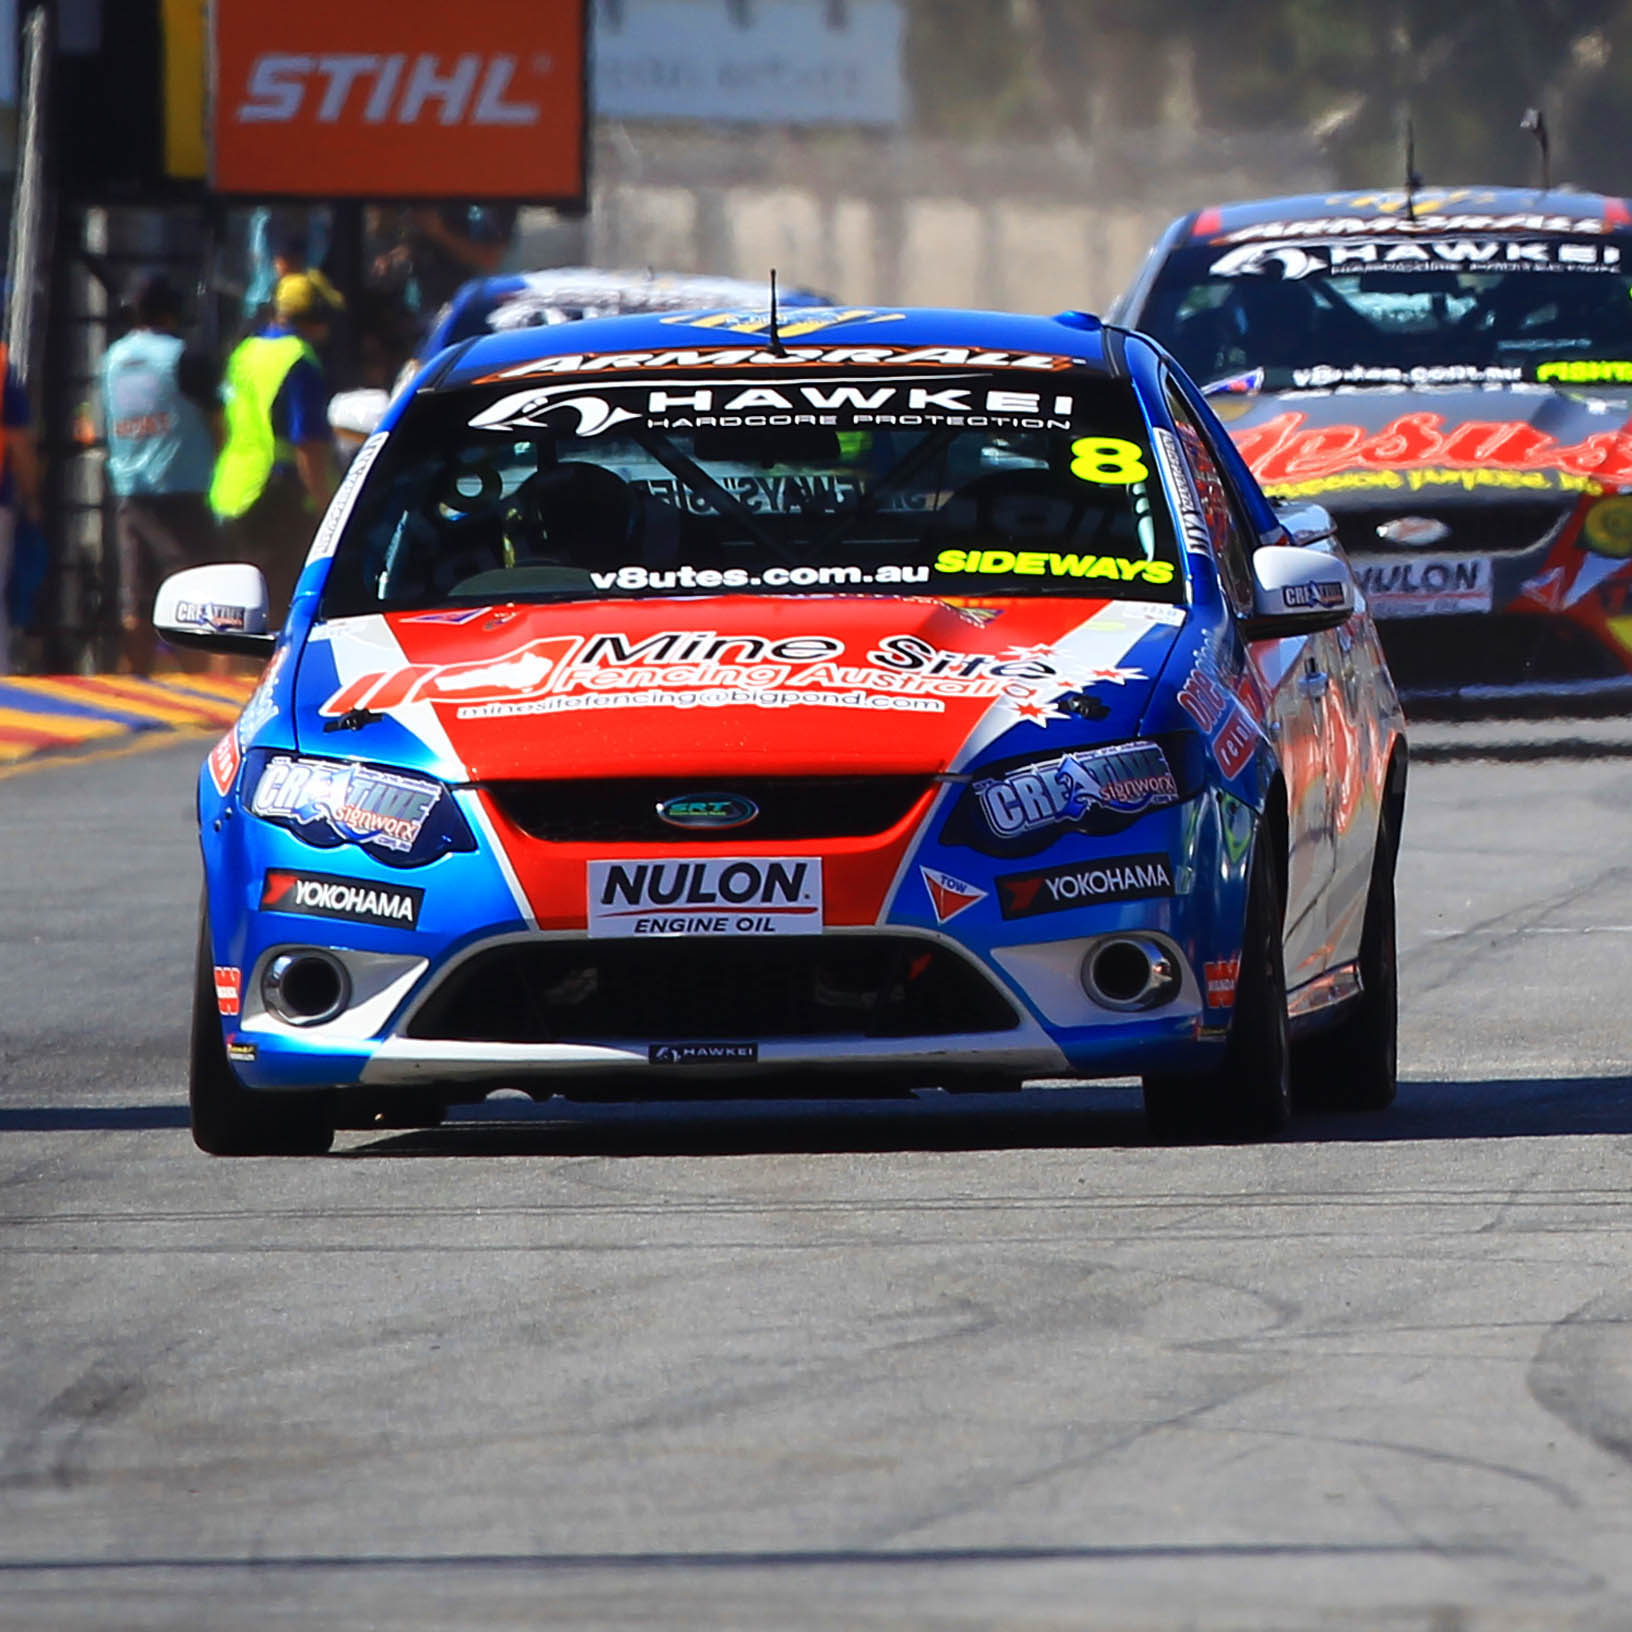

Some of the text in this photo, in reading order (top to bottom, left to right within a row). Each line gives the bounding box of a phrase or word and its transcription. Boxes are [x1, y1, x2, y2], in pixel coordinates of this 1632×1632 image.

[236, 52, 540, 126] STIHL
[1330, 243, 1620, 264] HAWKEI
[649, 387, 1073, 416] HAWKEI
[648, 415, 1071, 430] HARDCORE PROTECTION
[1071, 437, 1149, 485] 8
[590, 565, 929, 591] v8utes.com.au
[934, 550, 1175, 584] SIDEWAYS
[580, 631, 1057, 680] Mine Site
[556, 663, 1042, 699] Fencing Australia
[458, 688, 945, 719] minesitefencing@bigpond.com
[255, 762, 433, 820] CREATIVE
[987, 749, 1169, 831] CREATIVE
[1102, 775, 1174, 801] signworx
[335, 804, 421, 841] signworx
[599, 862, 808, 905] NULON
[939, 874, 968, 895] TOW
[1045, 864, 1170, 900] YOKOHAMA
[296, 880, 413, 921] YOKOHAMA
[634, 917, 776, 934] ENGINE OIL
[683, 1047, 753, 1057] HAWKEI
